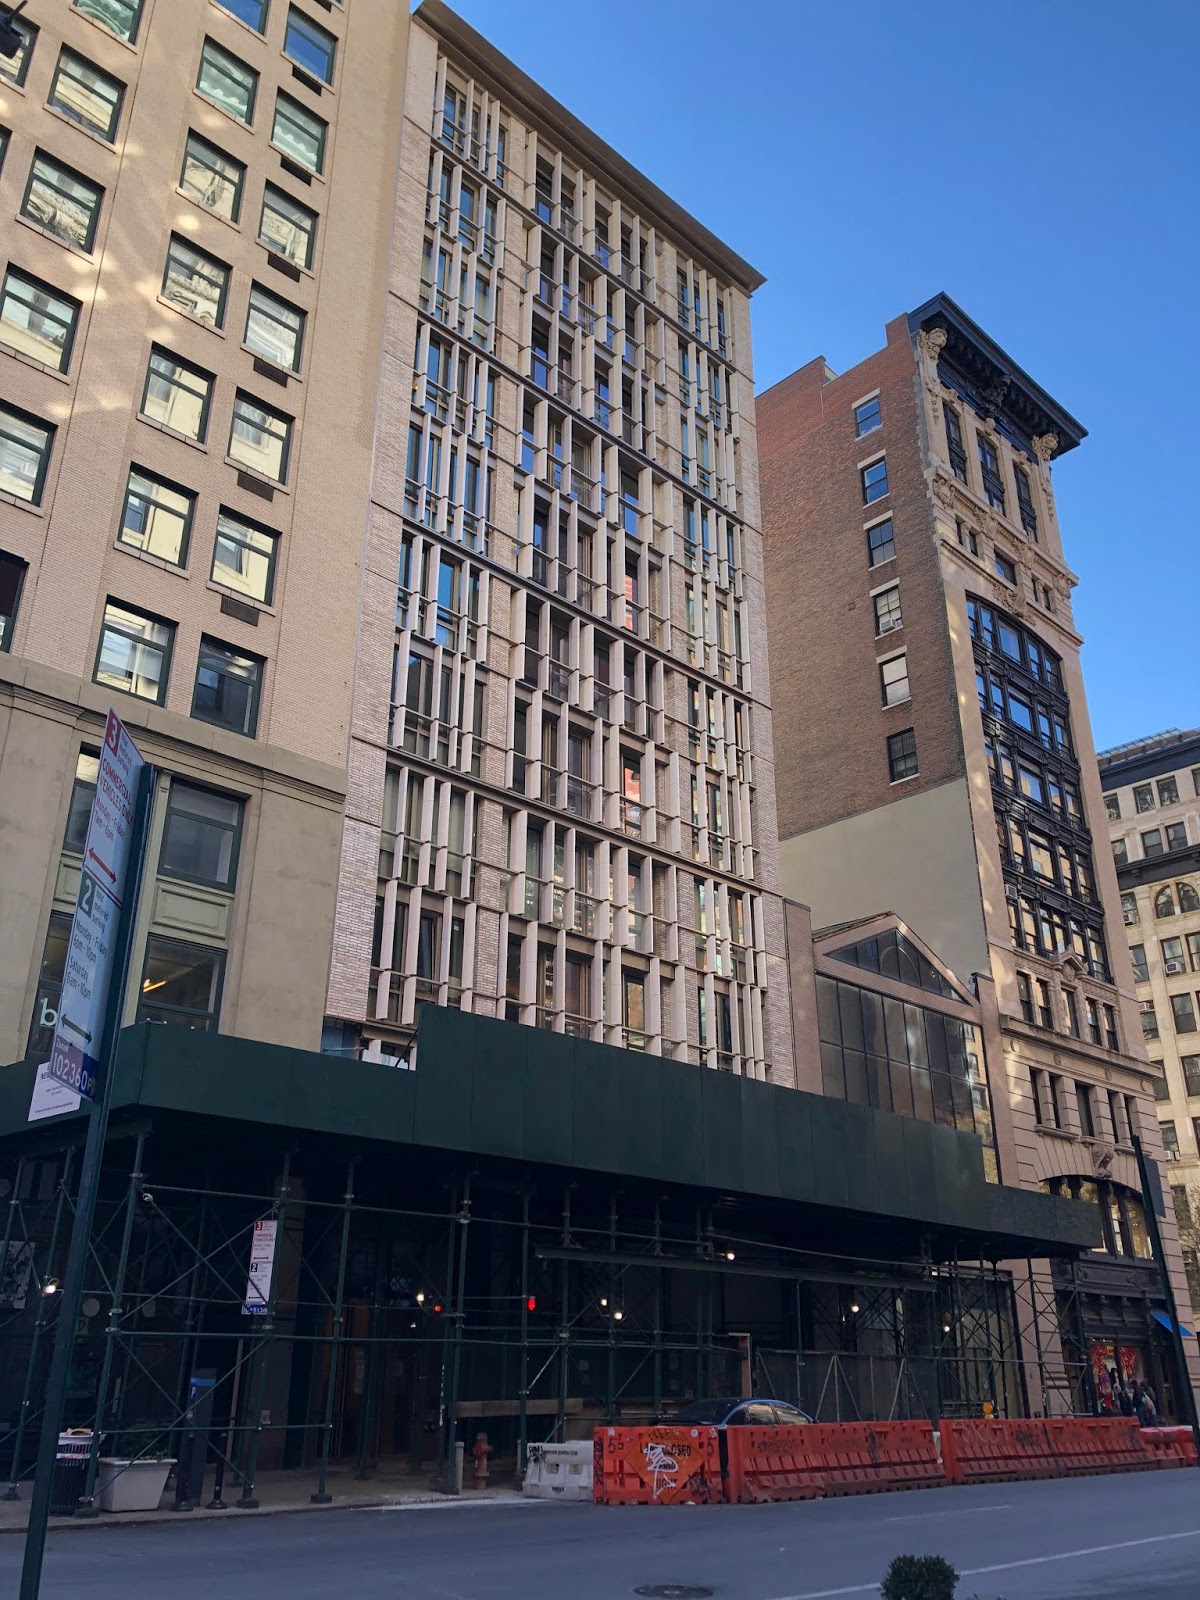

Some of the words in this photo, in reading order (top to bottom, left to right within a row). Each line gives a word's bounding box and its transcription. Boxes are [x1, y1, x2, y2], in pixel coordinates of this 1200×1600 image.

[108, 719, 118, 748] 3
[100, 776, 121, 812] VEHICLES
[102, 758, 131, 805] COMMERCIAL
[96, 798, 111, 823] Monday
[82, 879, 92, 911] 2
[73, 935, 84, 952] 6pm
[75, 919, 92, 944] Monday
[95, 936, 108, 959] Friday
[69, 956, 89, 981] Saturday
[52, 1052, 88, 1091] 102360
[251, 1263, 257, 1272] 2
